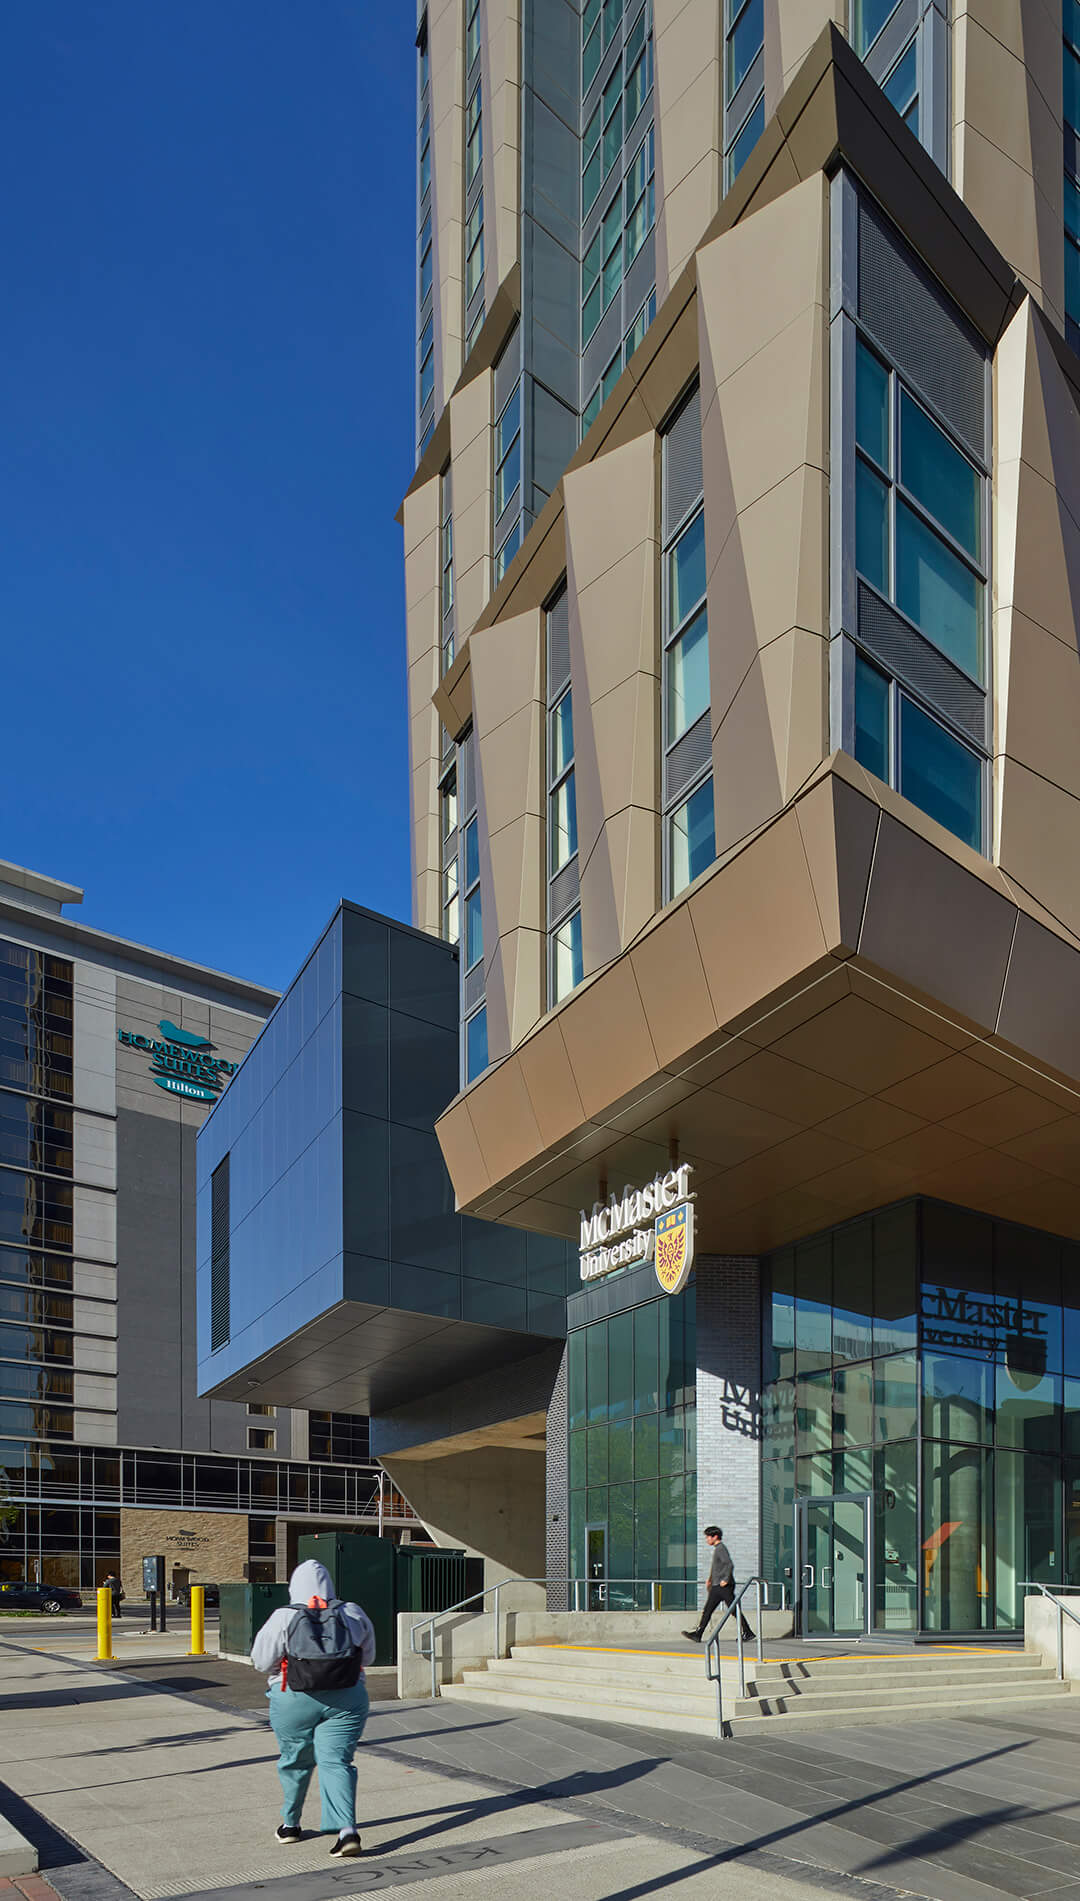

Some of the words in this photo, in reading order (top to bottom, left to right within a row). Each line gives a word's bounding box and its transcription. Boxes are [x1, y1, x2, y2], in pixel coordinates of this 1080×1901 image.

[152, 1052, 218, 1081] SUITES
[166, 1080, 205, 1097] Hilton
[578, 1162, 698, 1252] McMaster
[579, 1228, 655, 1282] University
[331, 1845, 503, 1885] KING
